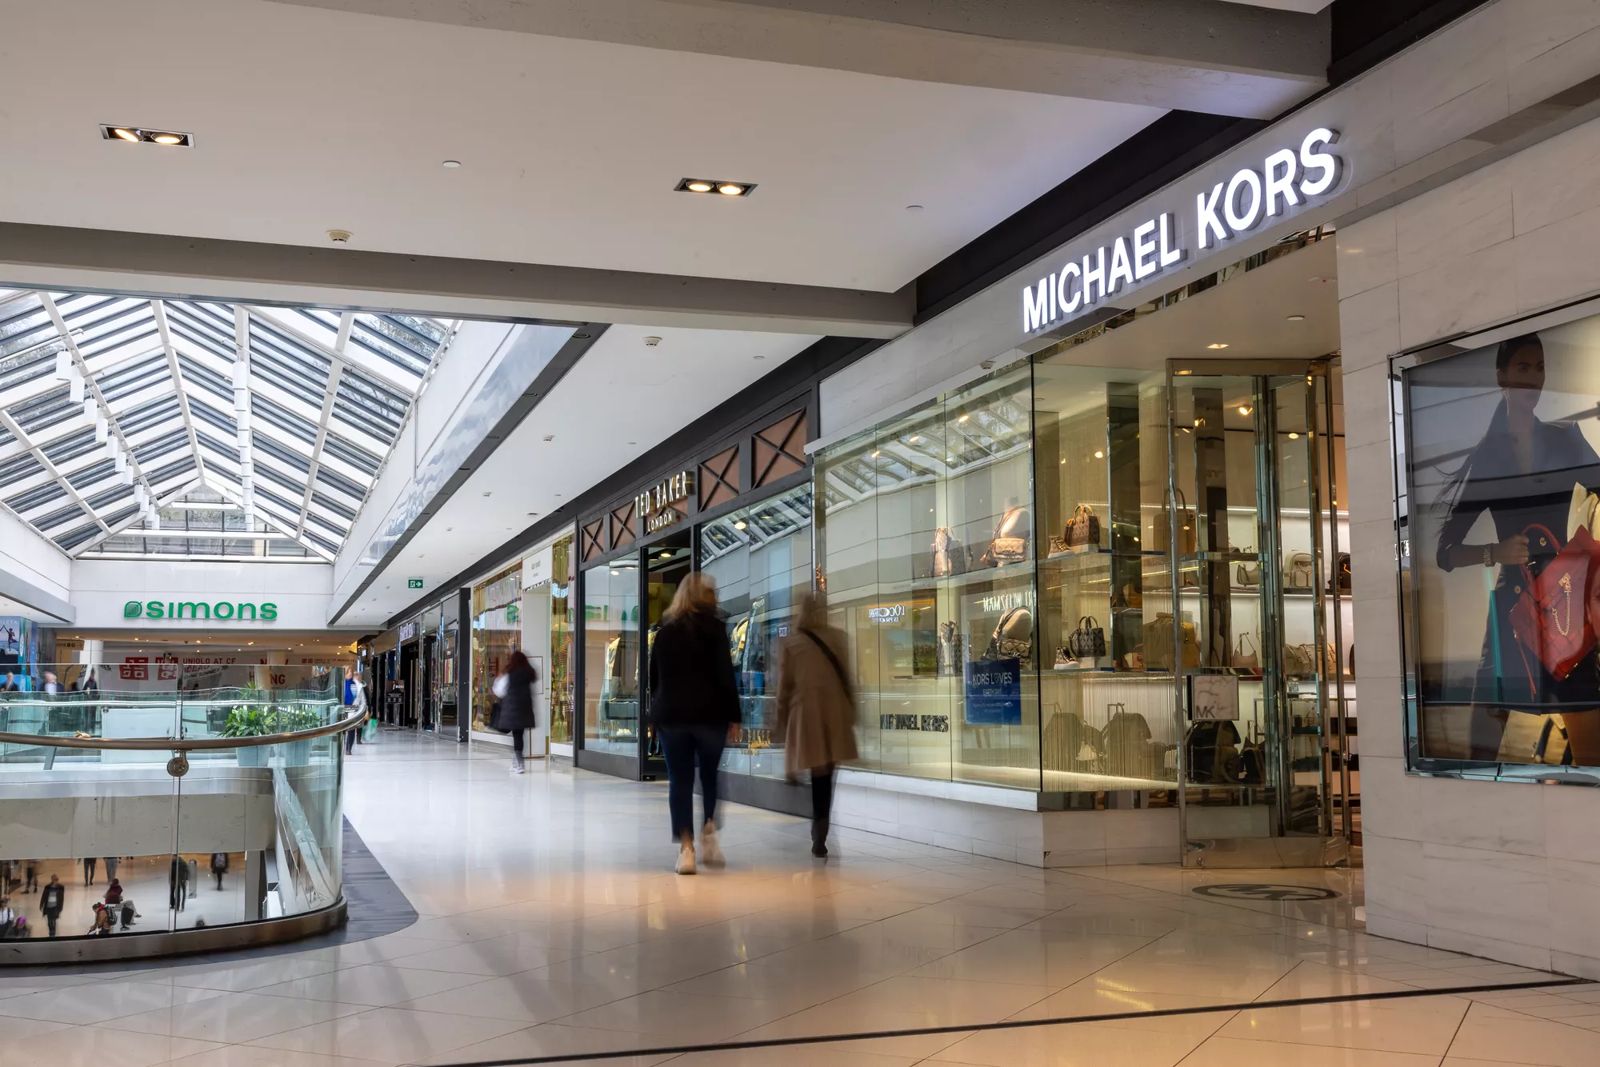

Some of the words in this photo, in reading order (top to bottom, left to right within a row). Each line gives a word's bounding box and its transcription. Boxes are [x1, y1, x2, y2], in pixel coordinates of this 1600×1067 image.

[1023, 212, 1184, 333] MICHAEL
[1197, 127, 1339, 249] KORS
[635, 490, 650, 519] TED
[656, 470, 688, 509] BAKER
[647, 511, 673, 532] LONDON
[1195, 705, 1216, 719] MK
